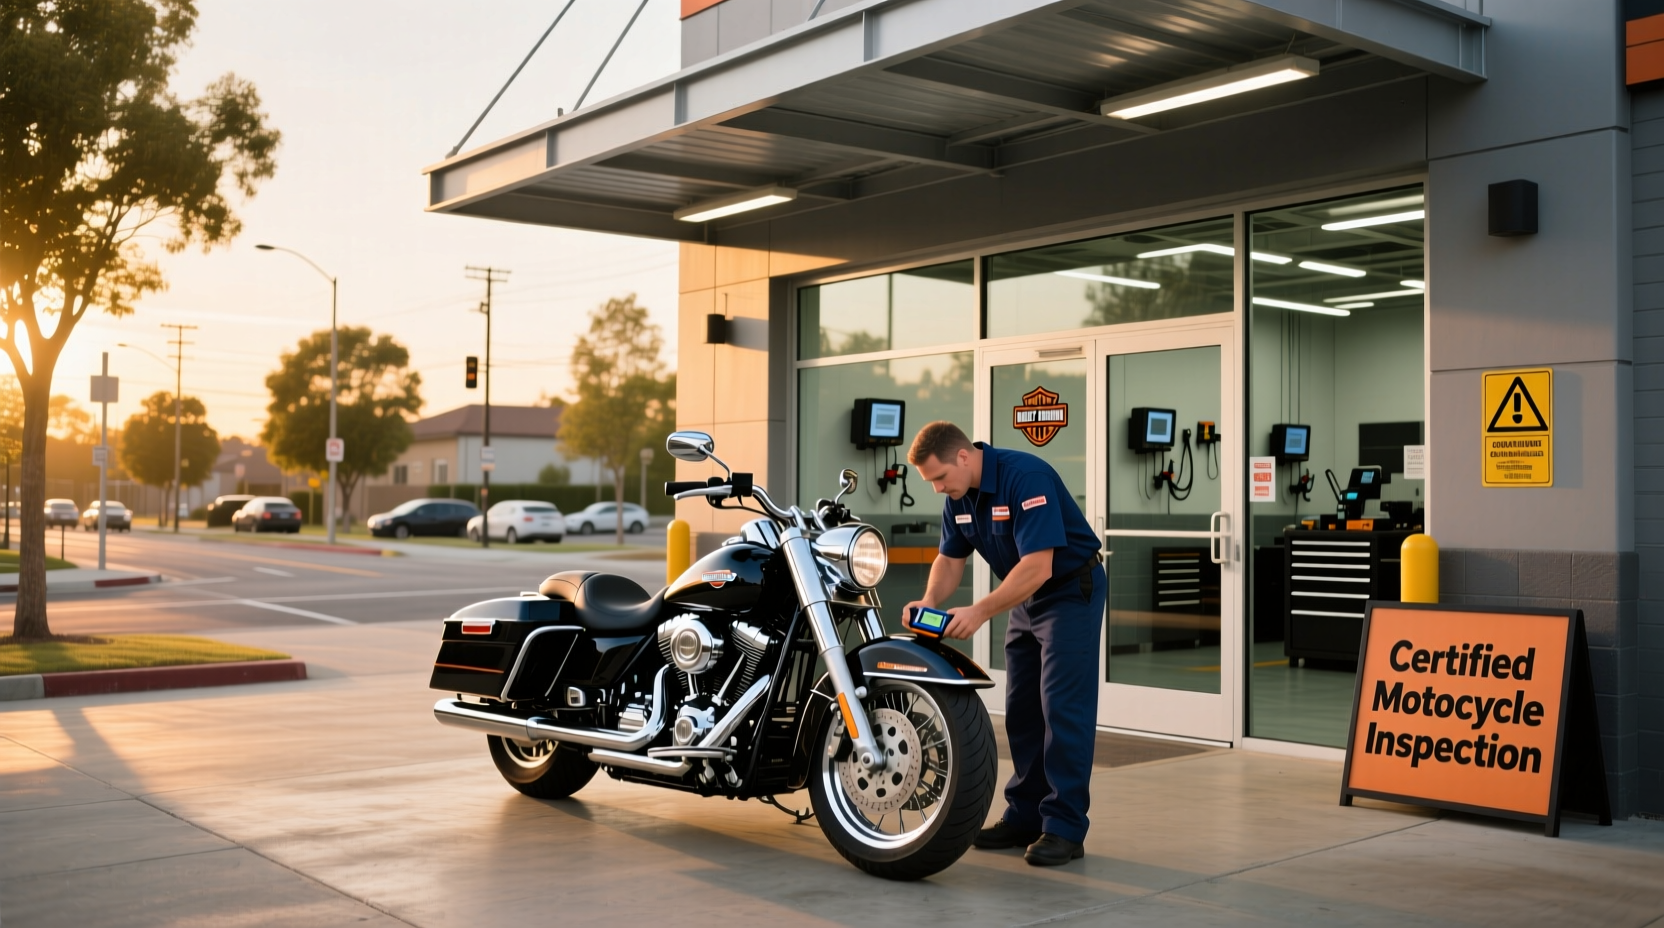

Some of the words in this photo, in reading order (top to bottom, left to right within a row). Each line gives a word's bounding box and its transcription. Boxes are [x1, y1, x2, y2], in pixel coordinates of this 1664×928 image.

[1389, 639, 1536, 681] Certified
[1372, 680, 1544, 730] Motocycle
[1364, 722, 1542, 774] Inspection
